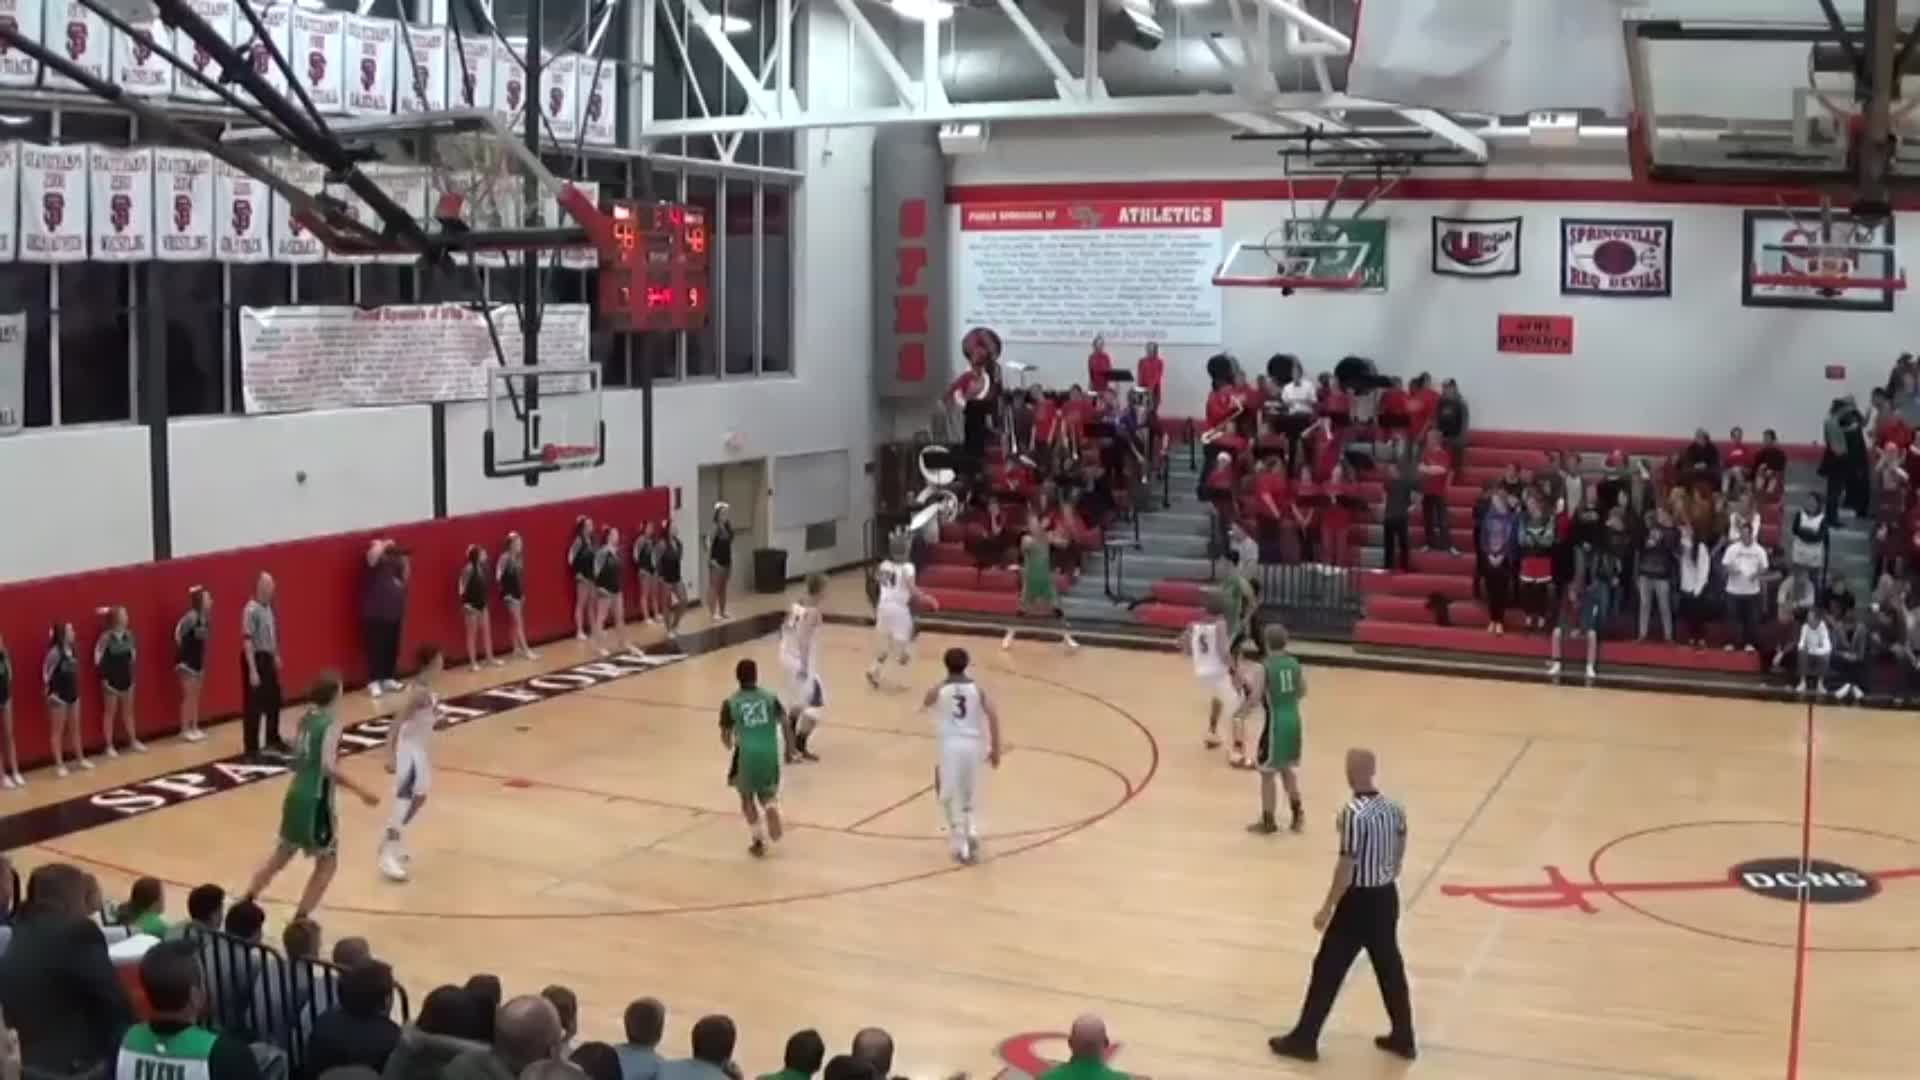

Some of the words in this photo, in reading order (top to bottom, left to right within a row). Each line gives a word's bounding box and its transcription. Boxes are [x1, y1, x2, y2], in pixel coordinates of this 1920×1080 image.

[1118, 206, 1212, 224] ATHLETICS
[1569, 226, 1663, 248] SPRINGVILLE
[1609, 268, 1662, 289] DEVILS
[1280, 669, 1294, 693] 11
[952, 695, 967, 720] 3
